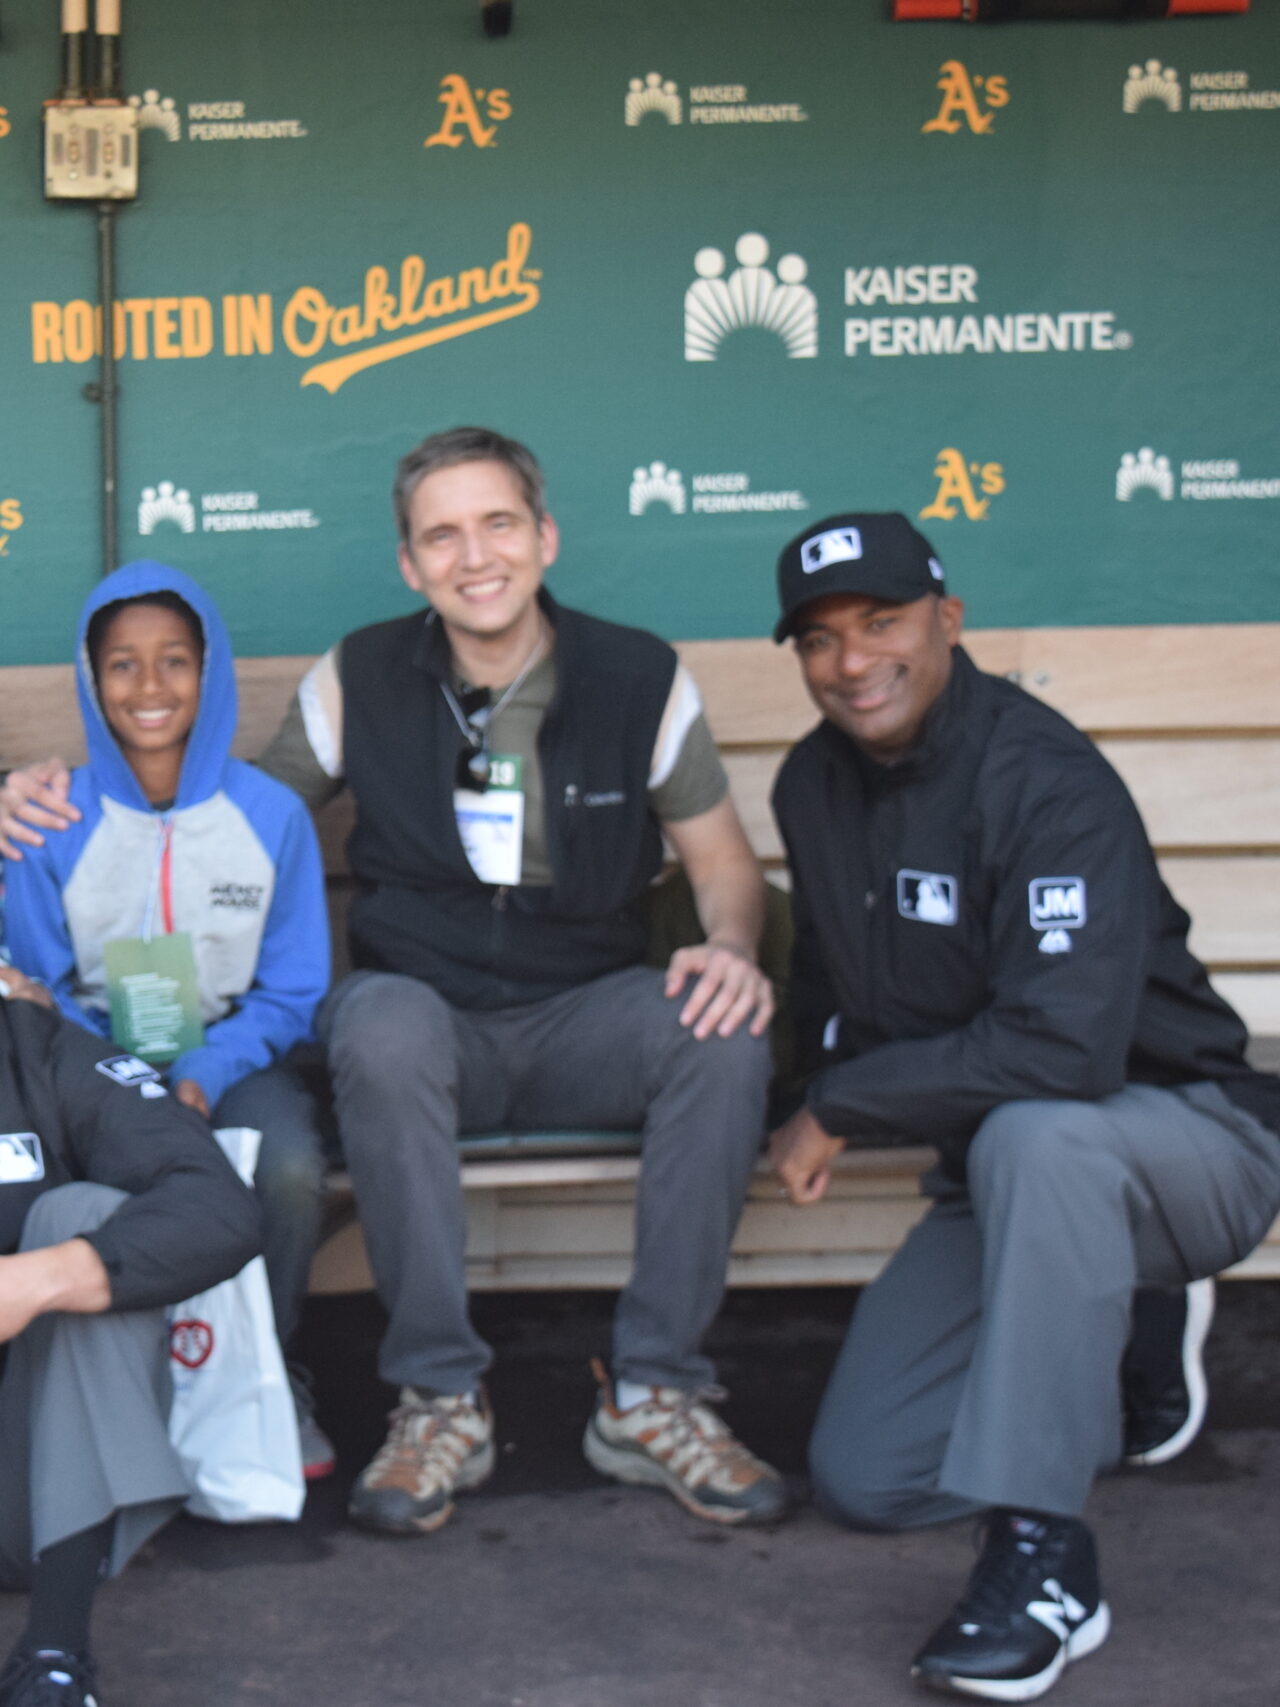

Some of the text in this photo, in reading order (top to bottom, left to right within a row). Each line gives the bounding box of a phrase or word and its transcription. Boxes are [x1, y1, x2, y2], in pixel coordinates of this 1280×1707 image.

[189, 102, 244, 119] KAISER
[425, 75, 511, 147] A's
[923, 61, 1008, 133] A's
[226, 296, 270, 353] IN
[283, 223, 540, 393] Oakland
[845, 265, 977, 305] KAISER
[845, 312, 1113, 356] PERMANENTE
[202, 493, 258, 511] KAISER
[920, 448, 1004, 520] A's
